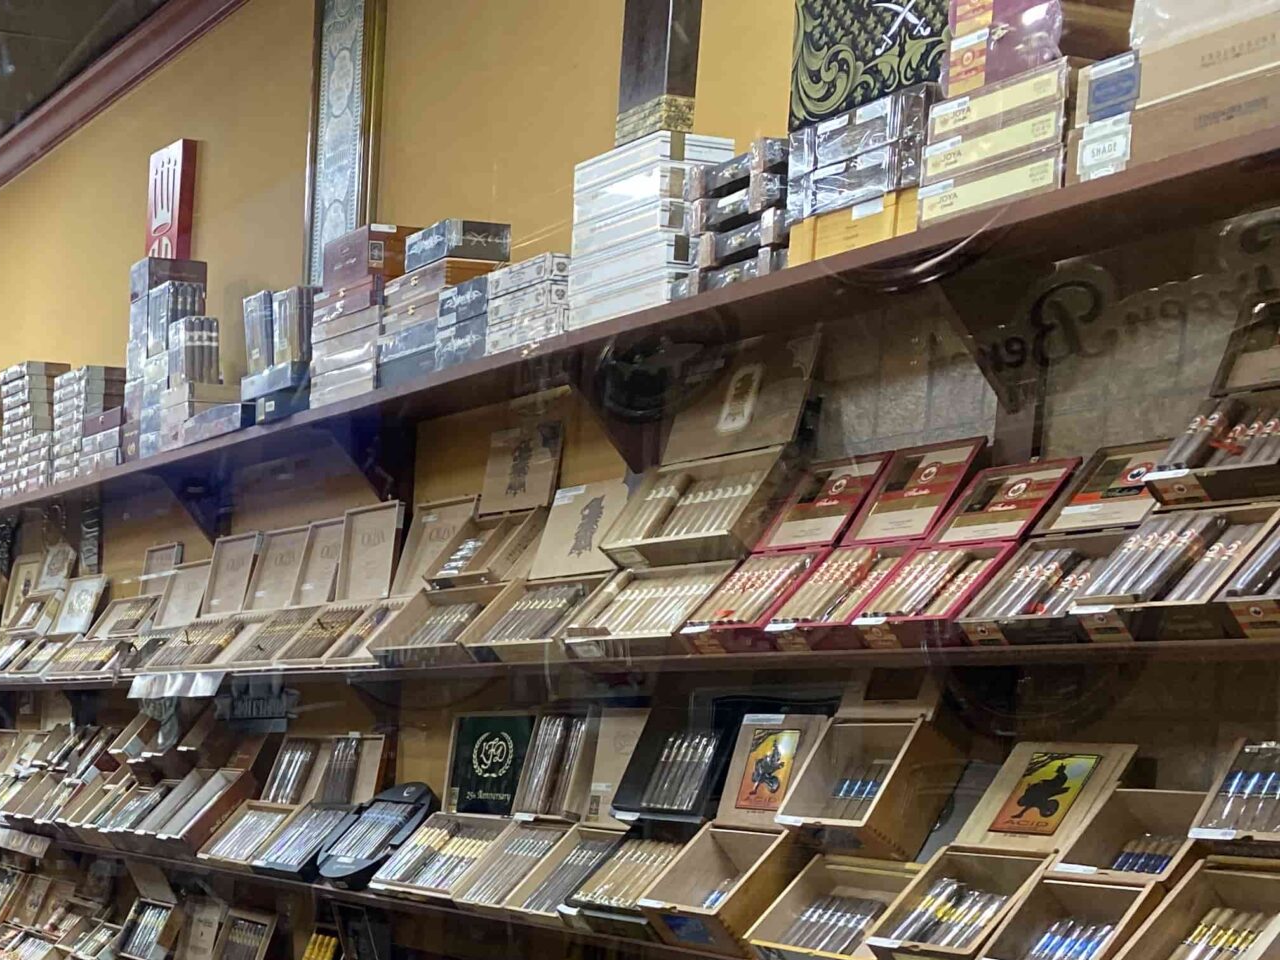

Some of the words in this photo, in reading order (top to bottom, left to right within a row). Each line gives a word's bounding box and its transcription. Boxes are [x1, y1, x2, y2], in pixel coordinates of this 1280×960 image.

[940, 150, 962, 162] JOYA
[937, 193, 958, 204] JOYA
[1003, 818, 1050, 828] ACID
